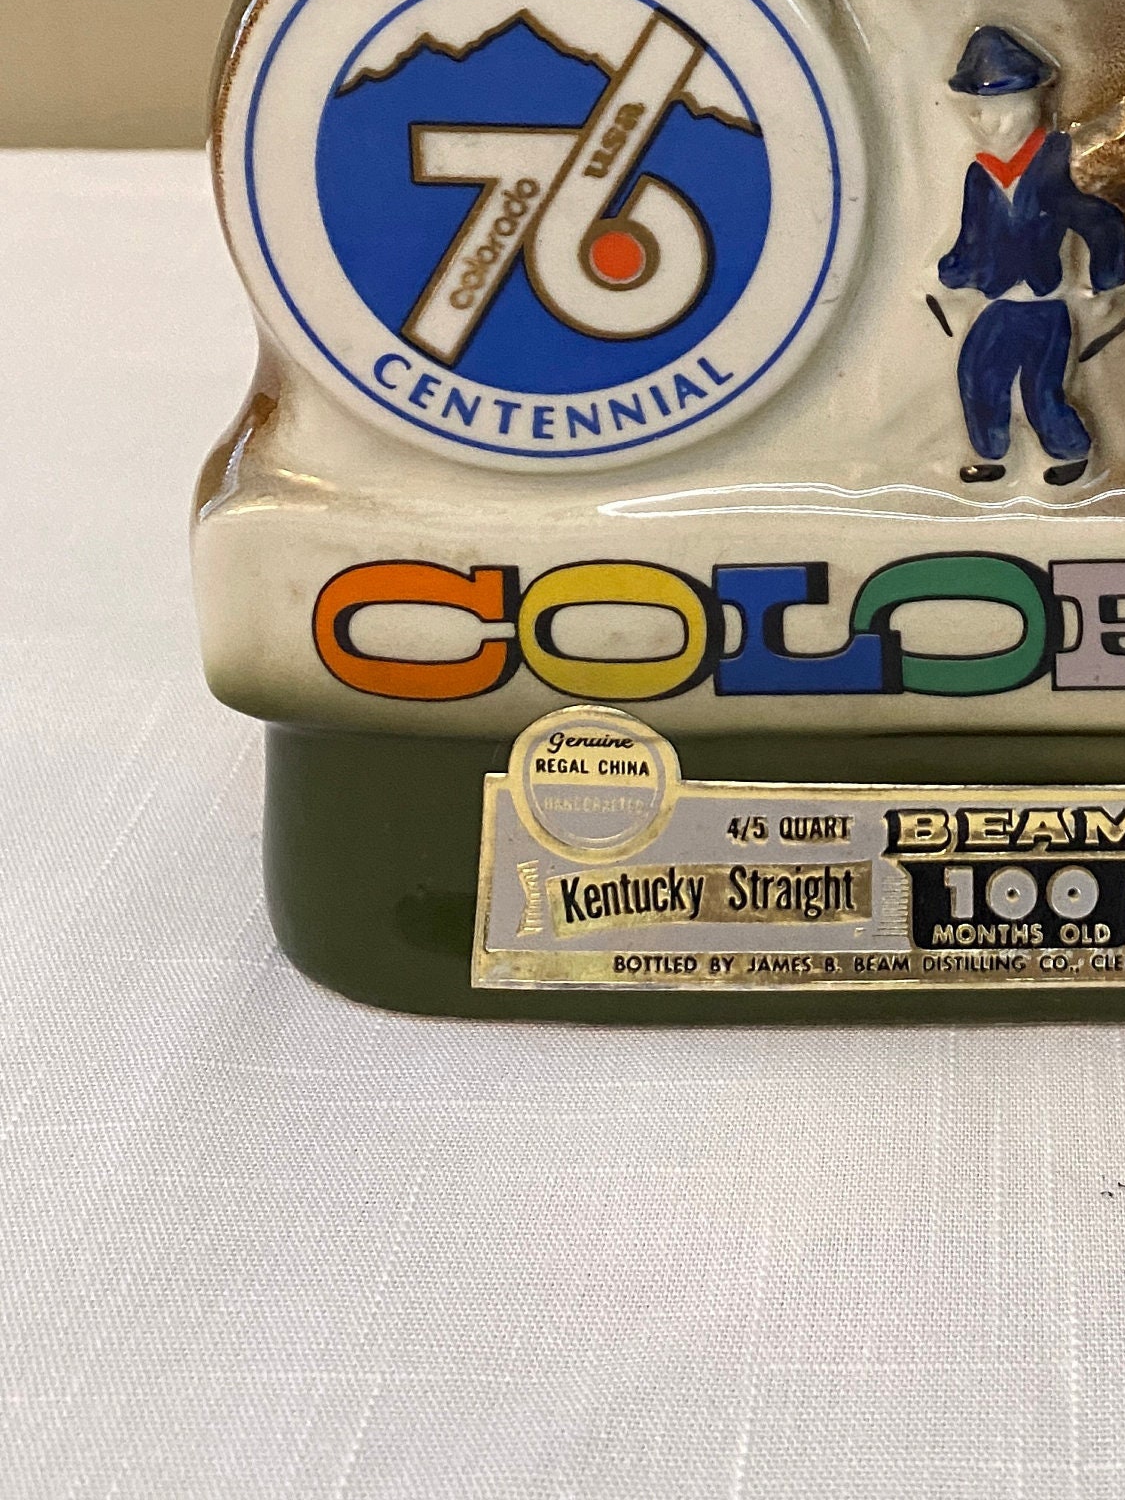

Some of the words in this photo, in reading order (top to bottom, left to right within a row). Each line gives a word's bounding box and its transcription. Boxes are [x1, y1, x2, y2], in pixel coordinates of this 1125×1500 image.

[401, 7, 716, 368] 76
[372, 352, 734, 440] CENTENNIAL
[546, 731, 634, 754] Genuine
[536, 758, 588, 775] REGAL
[598, 759, 650, 776] CHINA
[727, 815, 768, 841] 4/5
[780, 815, 851, 841] QUART
[560, 866, 704, 923] Kentucky
[728, 865, 854, 918] Straight
[944, 865, 1099, 920] 100
[932, 924, 1043, 945] MONTHS
[1059, 924, 1111, 945] OLD
[614, 955, 697, 973] BOTTLED
[710, 956, 734, 973] BY
[746, 956, 811, 973] JAMES
[824, 956, 842, 973] B.
[854, 957, 910, 972] BEAM
[923, 955, 1027, 972] DISTILLING
